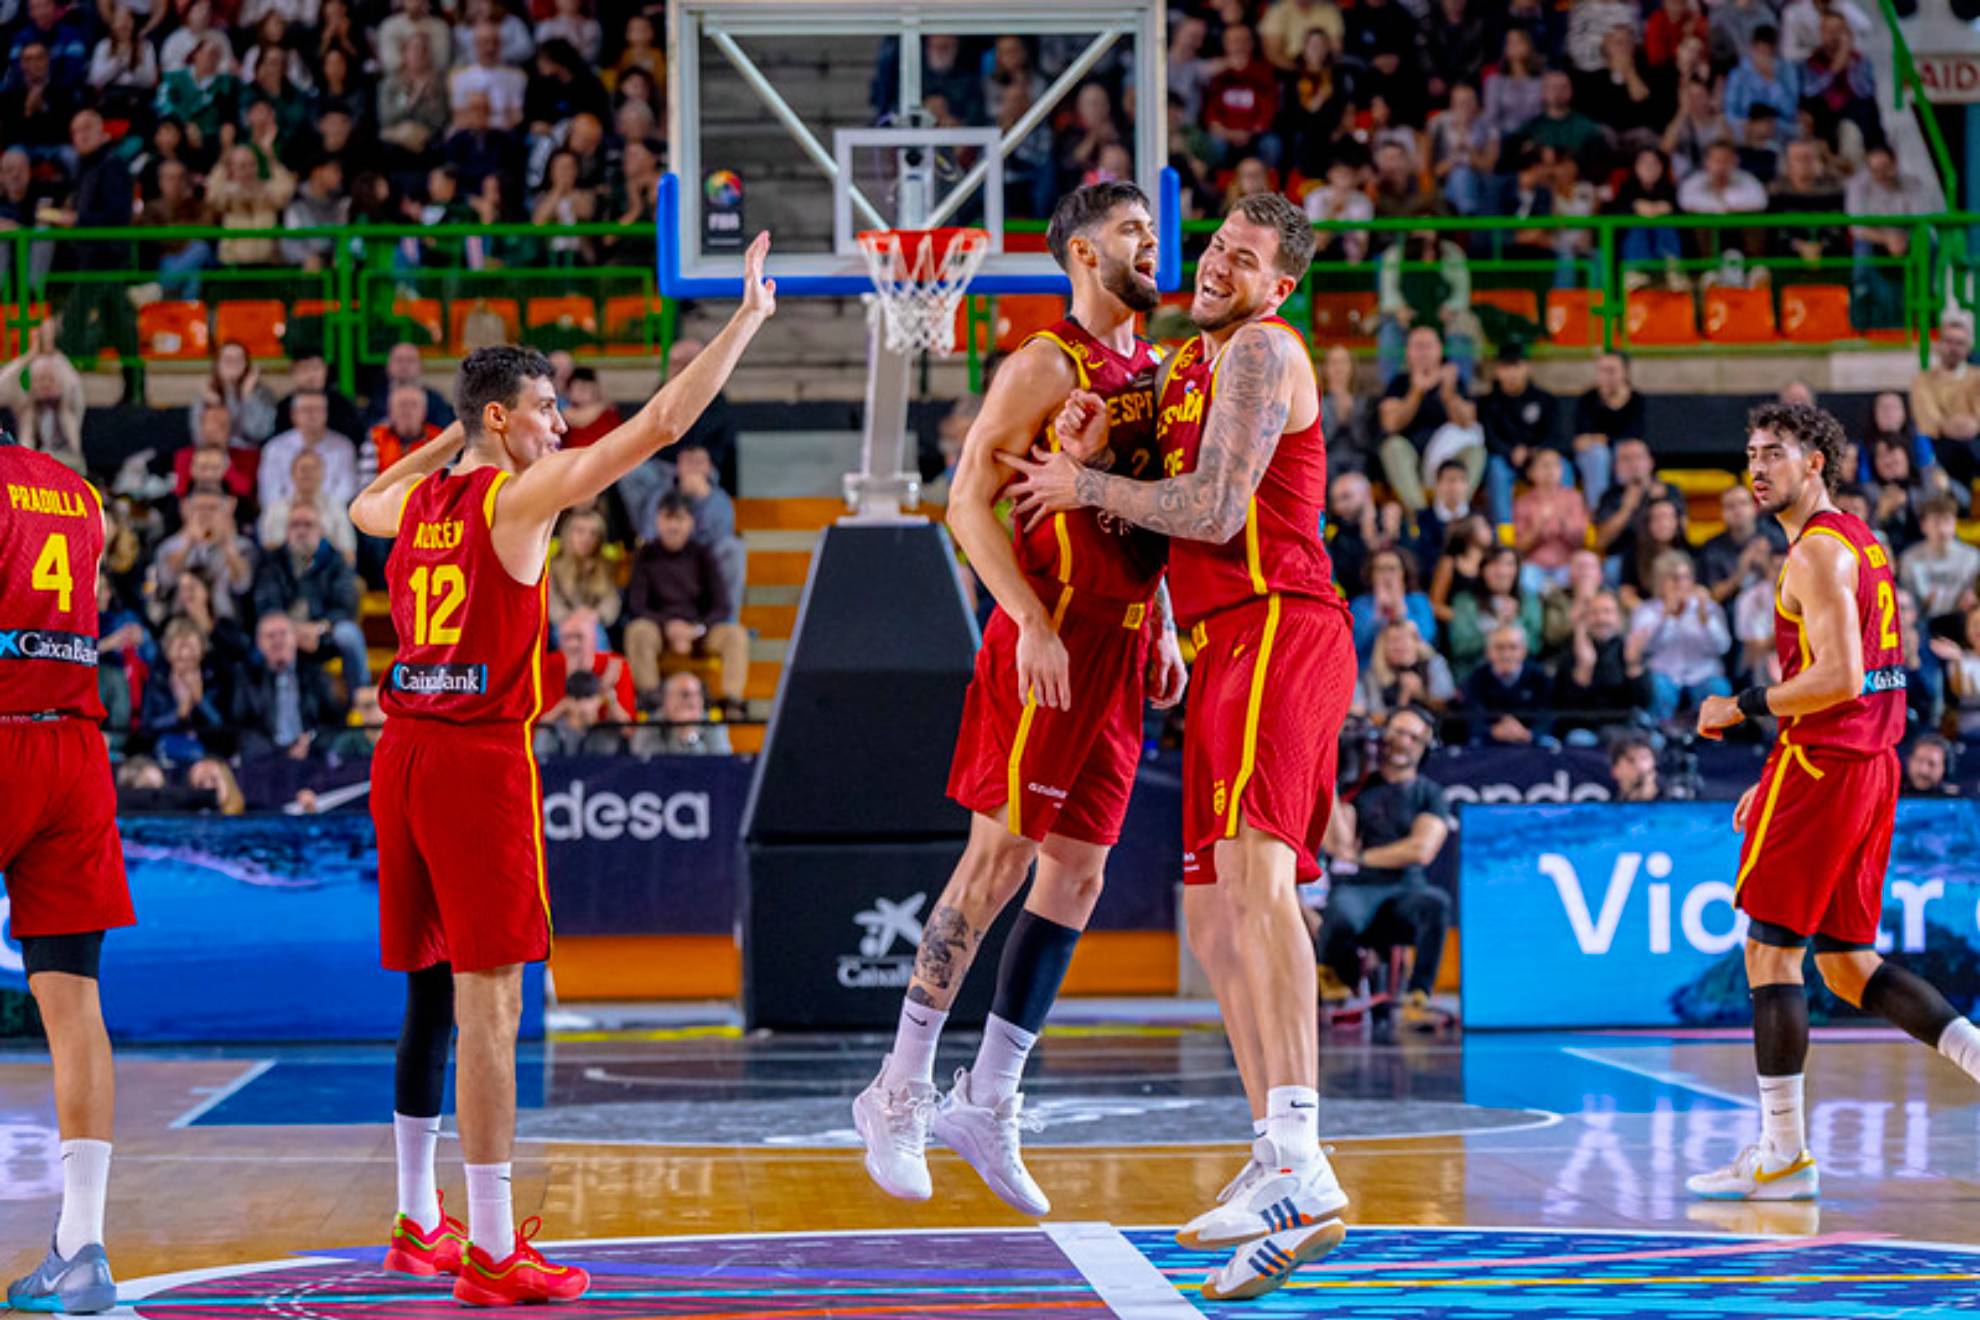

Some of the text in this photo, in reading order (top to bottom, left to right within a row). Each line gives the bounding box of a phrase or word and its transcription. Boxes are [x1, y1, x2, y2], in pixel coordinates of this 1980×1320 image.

[1904, 61, 1979, 92] AID
[7, 483, 88, 518] PRADILLA
[32, 533, 72, 612] 4
[408, 564, 466, 645] 12
[1877, 580, 1898, 650] 2
[544, 779, 711, 840] desa
[1539, 852, 1943, 955] Viar
